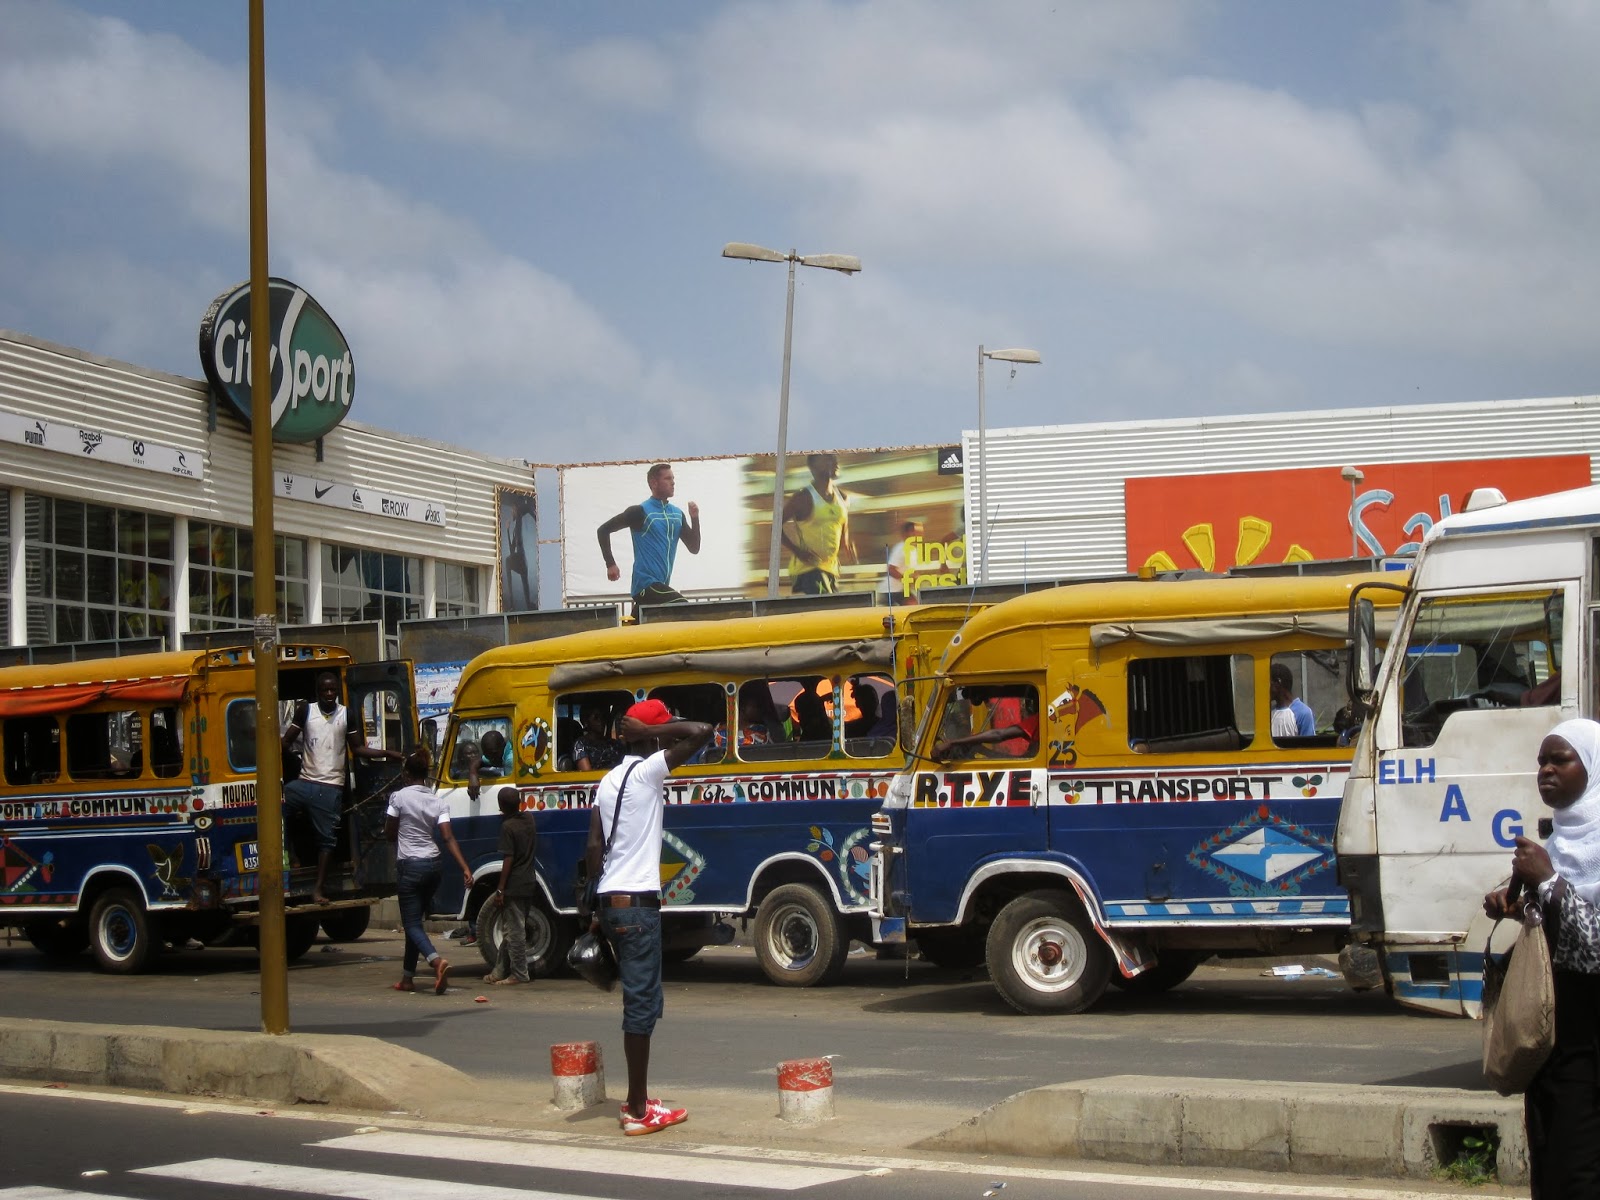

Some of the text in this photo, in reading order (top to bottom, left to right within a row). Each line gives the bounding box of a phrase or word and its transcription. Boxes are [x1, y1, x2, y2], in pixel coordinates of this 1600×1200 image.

[25, 431, 44, 446] PUMA
[133, 440, 145, 456] GO
[390, 501, 409, 516] ROXY
[903, 534, 967, 567] find
[226, 646, 314, 664] TBA
[1048, 740, 1077, 769] 25
[748, 780, 836, 802] COMMUN
[1085, 777, 1282, 804] TRANSPORT
[70, 798, 147, 818] COMMUN
[1379, 758, 1523, 848] ELH A G
